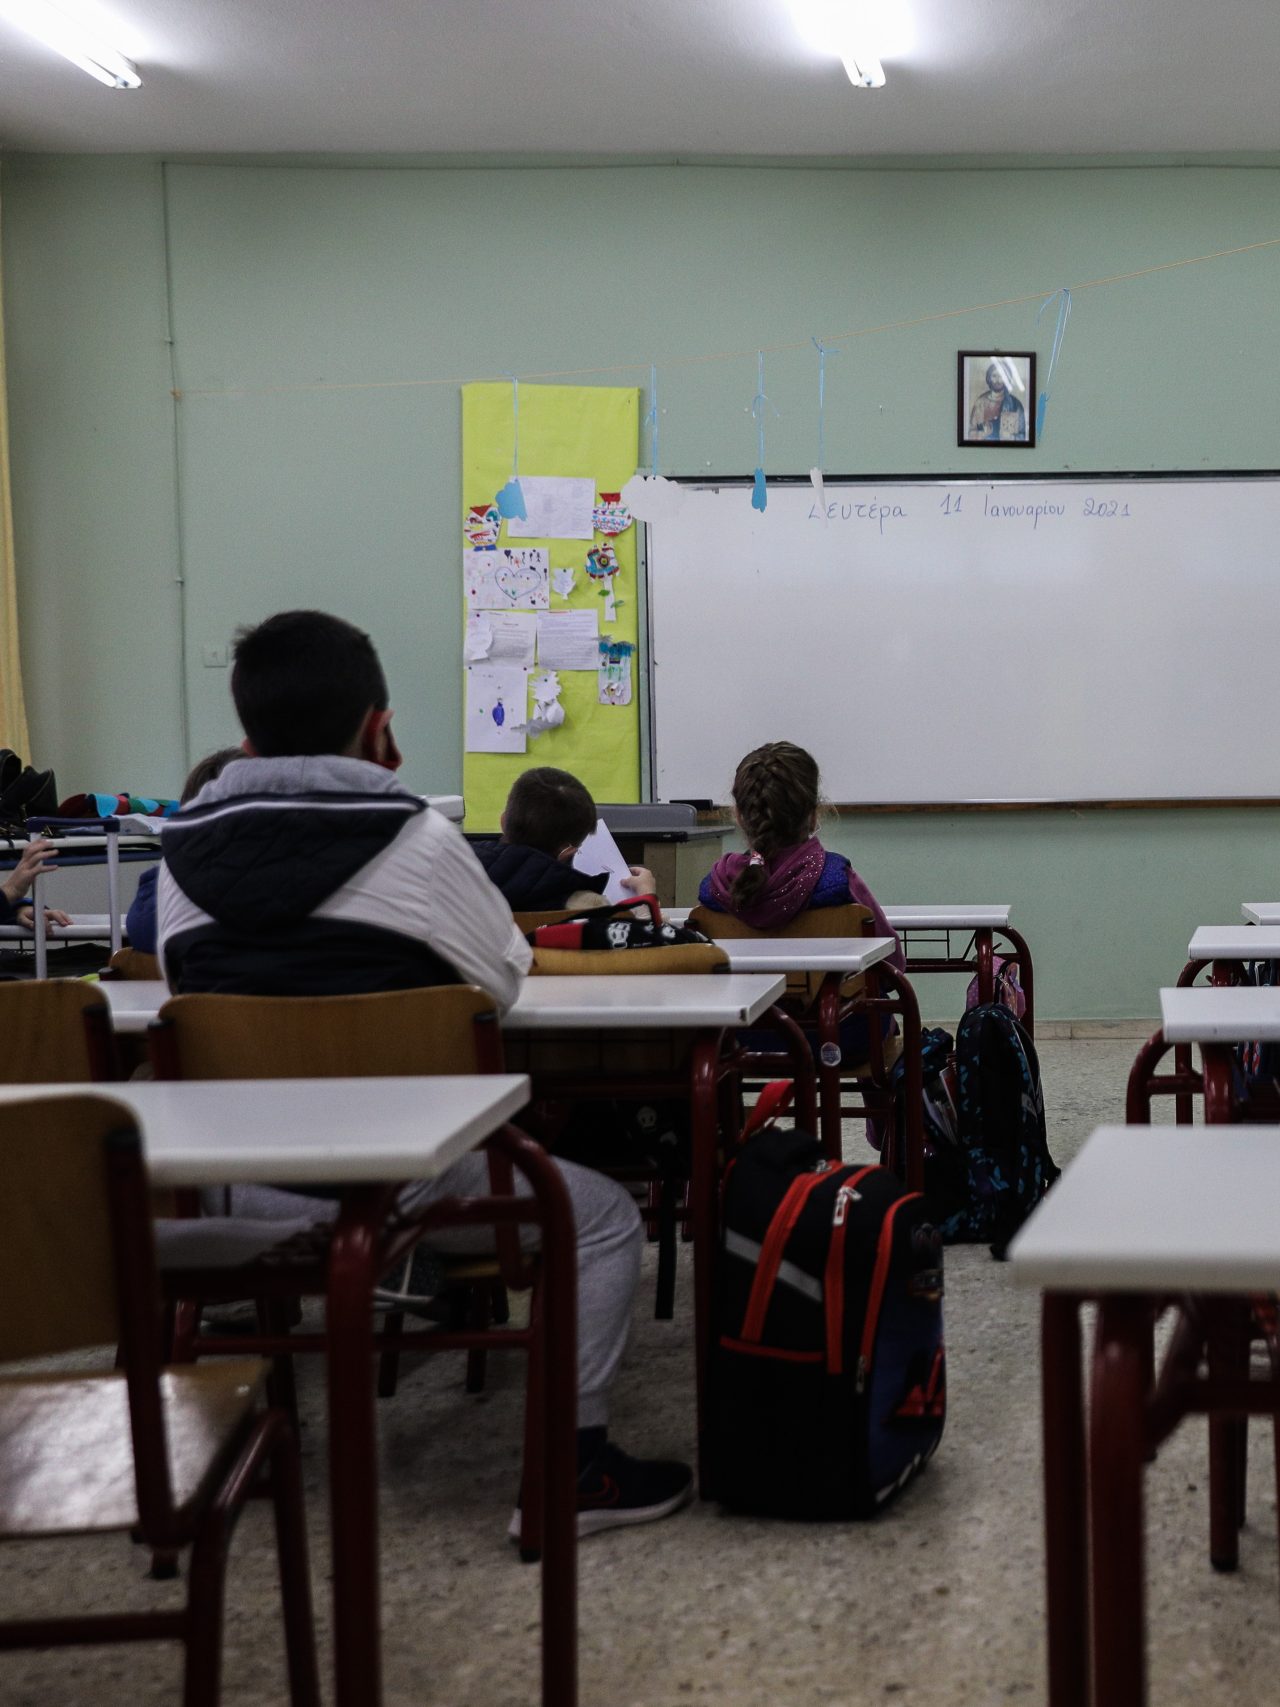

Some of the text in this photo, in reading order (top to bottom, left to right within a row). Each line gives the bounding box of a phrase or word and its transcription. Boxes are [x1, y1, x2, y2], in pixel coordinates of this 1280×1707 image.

[940, 493, 963, 515] 11
[984, 494, 1066, 530] Ιανουαρίου
[1083, 498, 1132, 518] 2021
